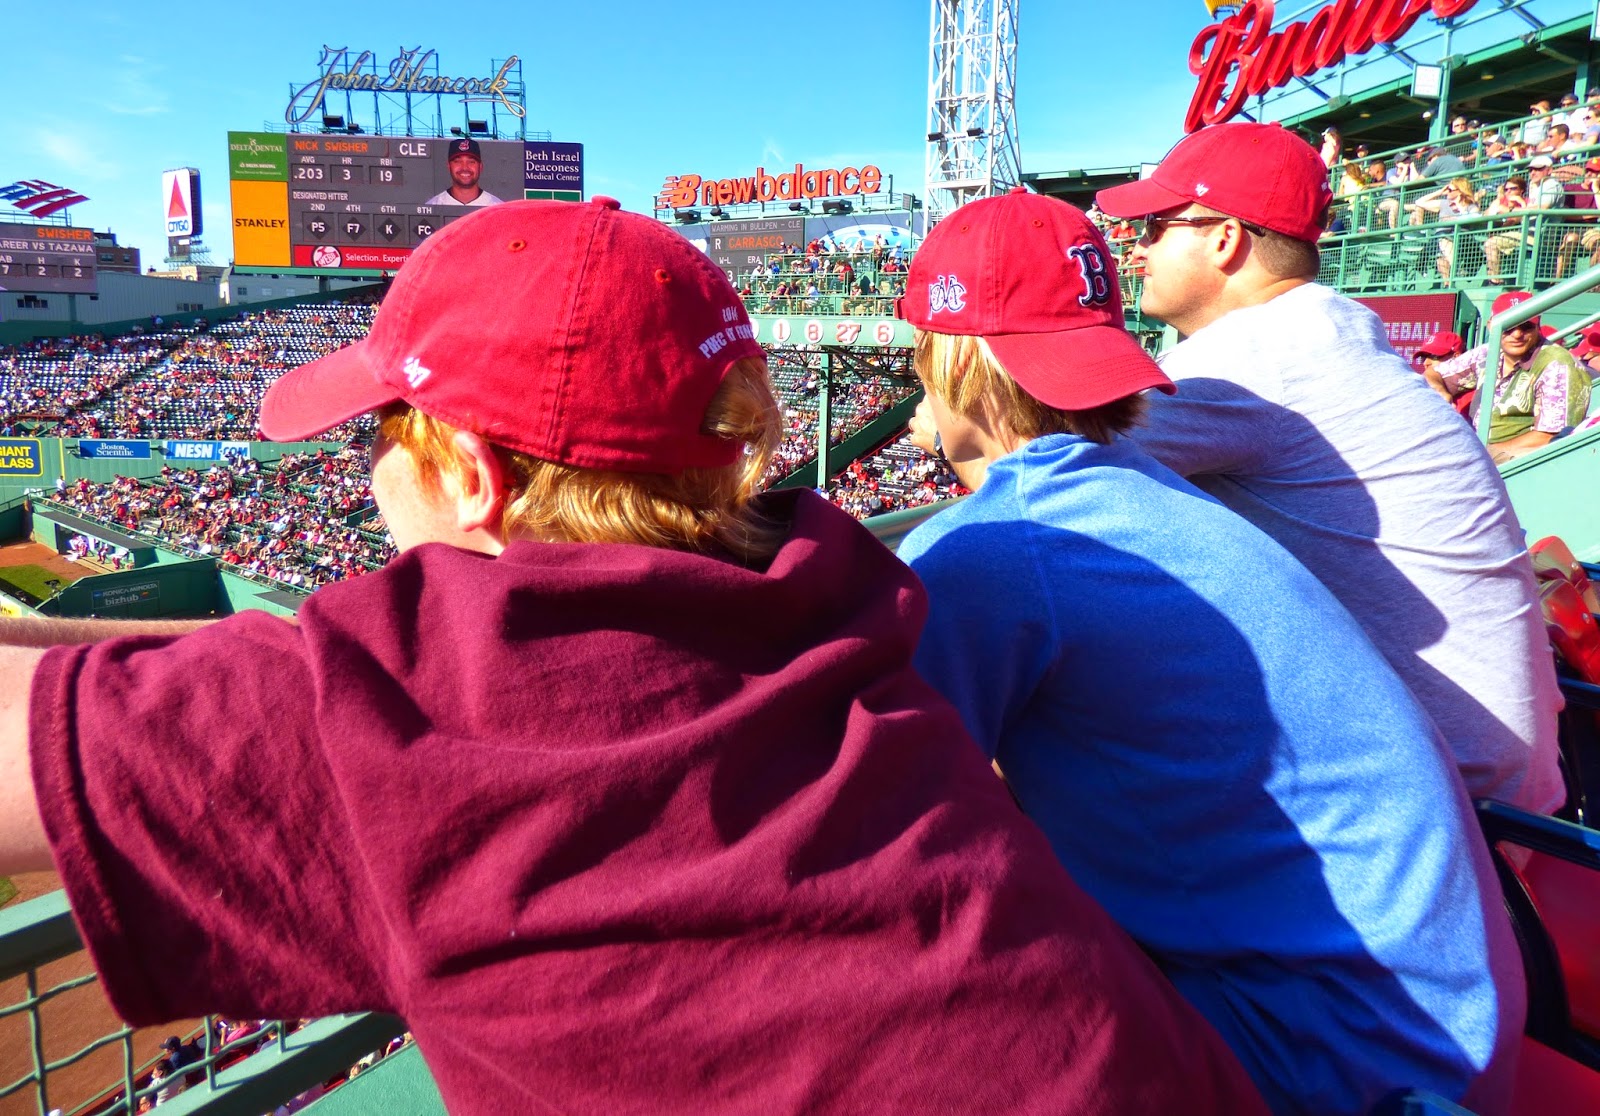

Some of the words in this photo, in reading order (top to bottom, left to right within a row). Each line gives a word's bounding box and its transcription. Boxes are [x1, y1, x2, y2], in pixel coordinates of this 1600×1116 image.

[285, 44, 380, 125] John
[380, 45, 526, 118] Hancock
[230, 143, 252, 151] DELTA
[255, 144, 284, 153] DENTAL
[294, 140, 319, 151] NICK
[325, 141, 369, 153] SWISHER
[399, 142, 427, 156] CLE
[300, 156, 316, 164] AVG
[341, 156, 353, 165] HR
[525, 150, 549, 161] Beth
[551, 150, 580, 162] Israel
[380, 158, 393, 166] RBI
[525, 161, 580, 173] Deaconess
[293, 168, 324, 180] .203
[343, 169, 351, 181] 3
[380, 170, 393, 182] 19
[525, 172, 554, 181] Medical
[556, 173, 580, 182] Center
[292, 191, 327, 200] DESIGNATED
[328, 192, 349, 201] HITTER
[310, 203, 326, 211] 2ND
[345, 204, 361, 212] 4TH
[380, 205, 396, 213] 6TH
[416, 206, 432, 215] 8TH
[168, 219, 189, 232] CITGO
[235, 218, 286, 228] STANLEY
[311, 222, 326, 232] P5
[347, 223, 360, 234] F7
[711, 224, 738, 232] WARMING
[740, 223, 747, 231] IN
[750, 221, 778, 231] BULLPEN
[788, 220, 801, 229] CLE
[37, 228, 92, 240] SWISHER
[385, 224, 393, 235] K
[417, 225, 432, 235] FC
[32, 241, 46, 251] VS
[49, 242, 94, 253] TAZAWA
[714, 238, 722, 250] R
[728, 235, 784, 249] CARRASCO
[0, 255, 13, 263] AB
[37, 256, 46, 264] H
[73, 258, 81, 266] K
[345, 253, 381, 262] Selection.
[719, 256, 731, 265] W-L
[747, 255, 760, 264] ERA
[1, 264, 9, 275] 7
[38, 266, 46, 276] 2
[74, 267, 82, 278] 2
[1066, 243, 1110, 307] B
[777, 322, 784, 340] 1
[808, 323, 819, 341] 8
[836, 323, 861, 342] 27
[877, 324, 889, 342] 6
[100, 442, 125, 450] Boston
[174, 443, 214, 459] NESN
[96, 447, 134, 457] Scientific
[0, 457, 34, 469] LASS
[102, 588, 129, 597] KONICA
[130, 583, 158, 592] MINOLTA
[105, 594, 139, 606] bizhub
